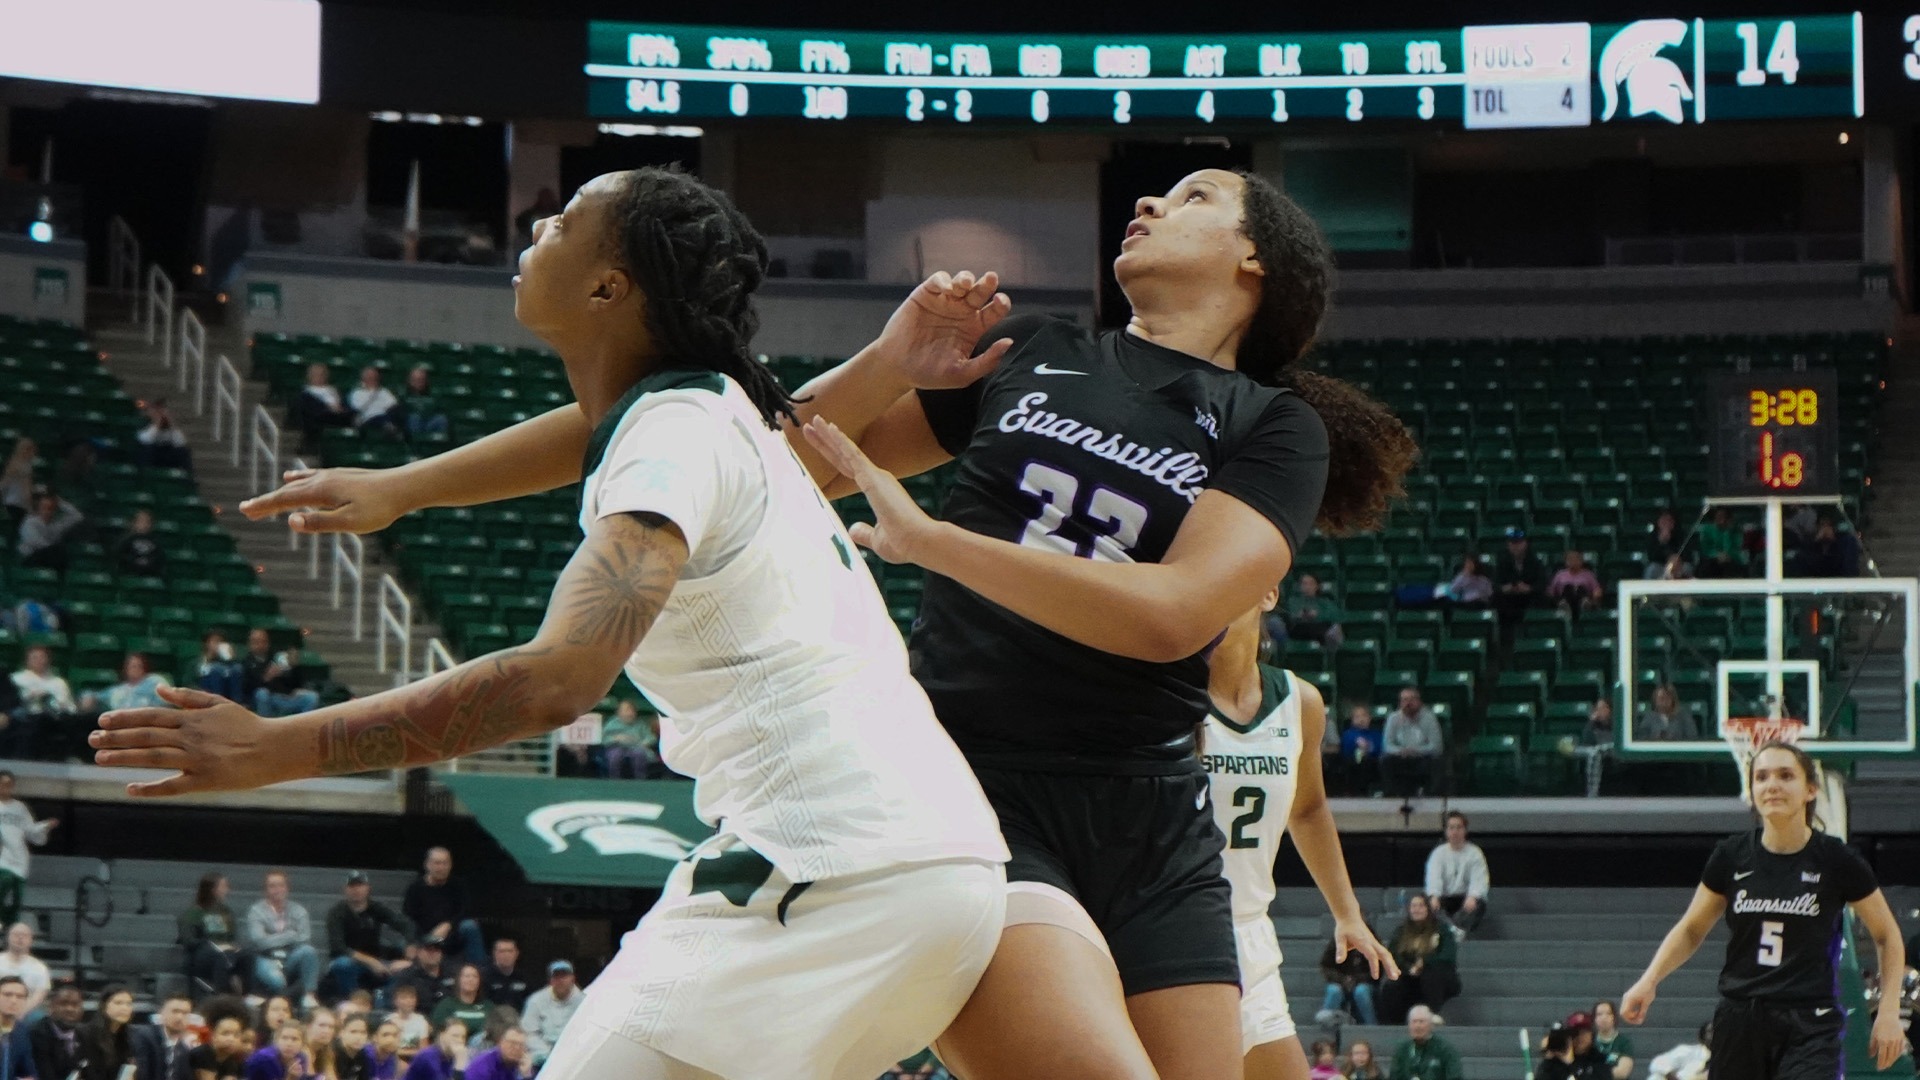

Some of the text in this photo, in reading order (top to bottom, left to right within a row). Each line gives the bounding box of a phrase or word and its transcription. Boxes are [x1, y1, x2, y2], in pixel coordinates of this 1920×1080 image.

[801, 40, 850, 73] FT%
[1184, 44, 1227, 77] AST
[1258, 43, 1301, 76] BLK
[1339, 42, 1369, 75] TO
[1405, 41, 1447, 74] STL
[1473, 45, 1534, 68] FOULS
[1736, 21, 1799, 86] 14
[803, 86, 848, 120] 100
[1113, 90, 1131, 123] 2
[1196, 90, 1215, 123] 4
[1271, 89, 1289, 122] 1
[1346, 88, 1364, 121] 2
[1417, 86, 1435, 120] 3
[1473, 87, 1573, 113] TOL 4
[1750, 389, 1818, 426] 3:28
[1760, 432, 1803, 487] 1.8
[1202, 755, 1289, 775] SPARTANS
[1230, 786, 1267, 849] 2
[1733, 889, 1820, 916] Evansville
[1757, 921, 1784, 967] 5
